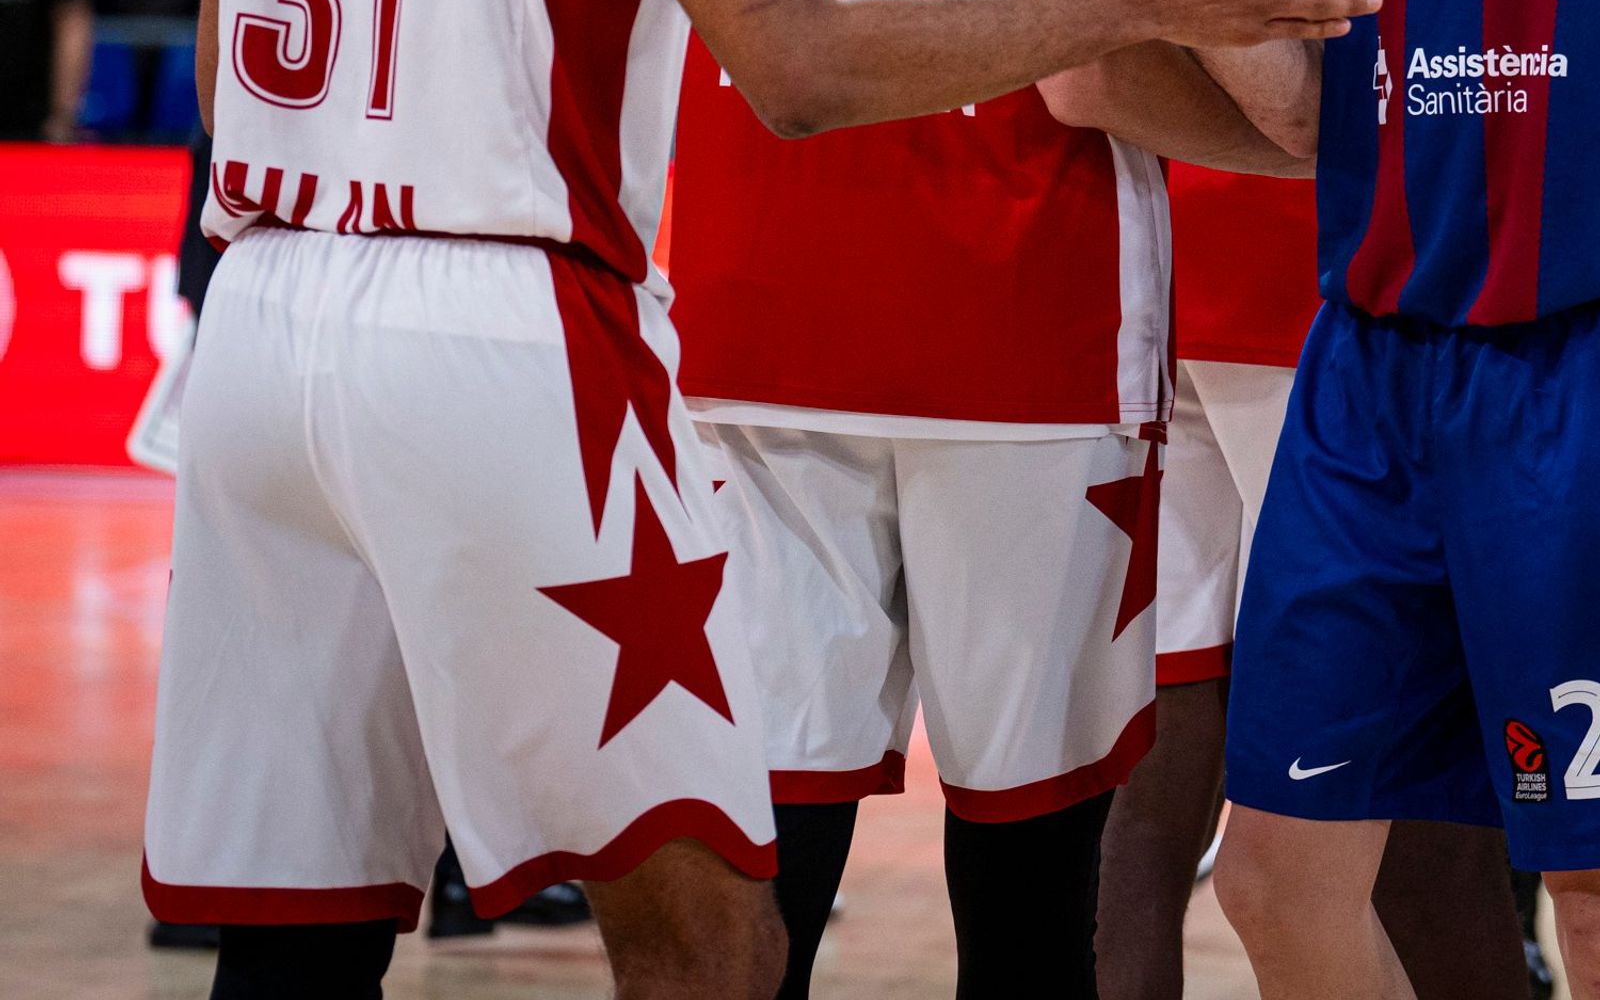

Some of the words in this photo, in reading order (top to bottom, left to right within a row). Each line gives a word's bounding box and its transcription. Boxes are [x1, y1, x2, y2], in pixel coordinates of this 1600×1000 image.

[1407, 45, 1568, 79] Assistència
[1407, 82, 1528, 116] Sanitària
[1516, 773, 1546, 782] TURKISH
[1516, 782, 1547, 792] AIRLINES
